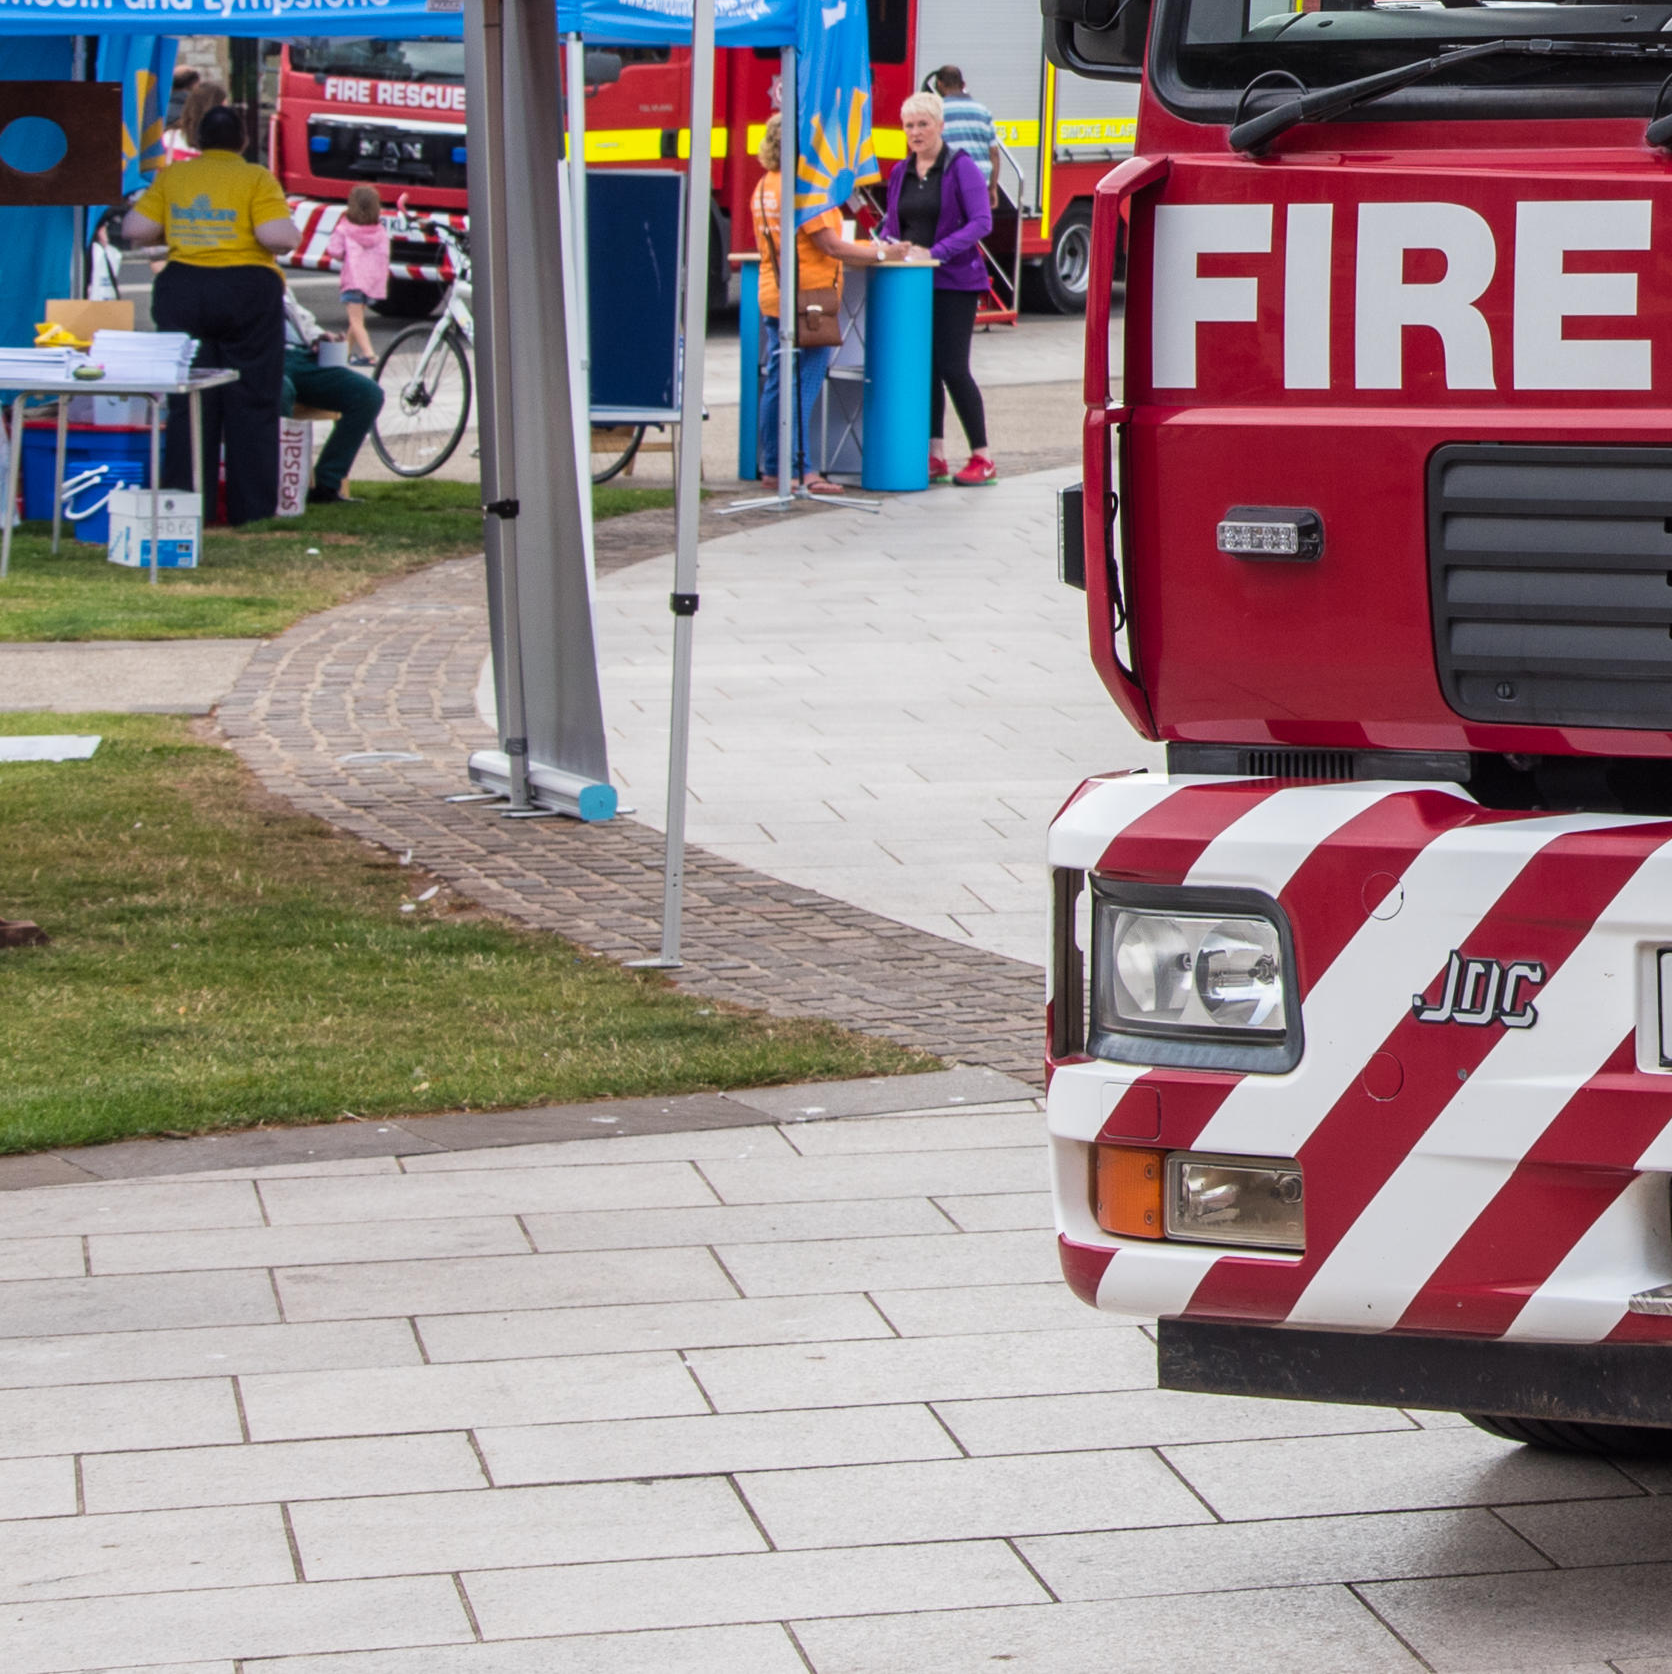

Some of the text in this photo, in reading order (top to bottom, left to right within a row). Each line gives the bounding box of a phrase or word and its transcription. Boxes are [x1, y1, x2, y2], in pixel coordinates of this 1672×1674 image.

[324, 78, 466, 111] FIRE RESCUE
[359, 139, 423, 160] MAN
[1060, 124, 1101, 139] SMOKE
[1154, 199, 1653, 392] FIRE
[280, 429, 304, 511] seasalt
[1412, 949, 1547, 1029] JDC
